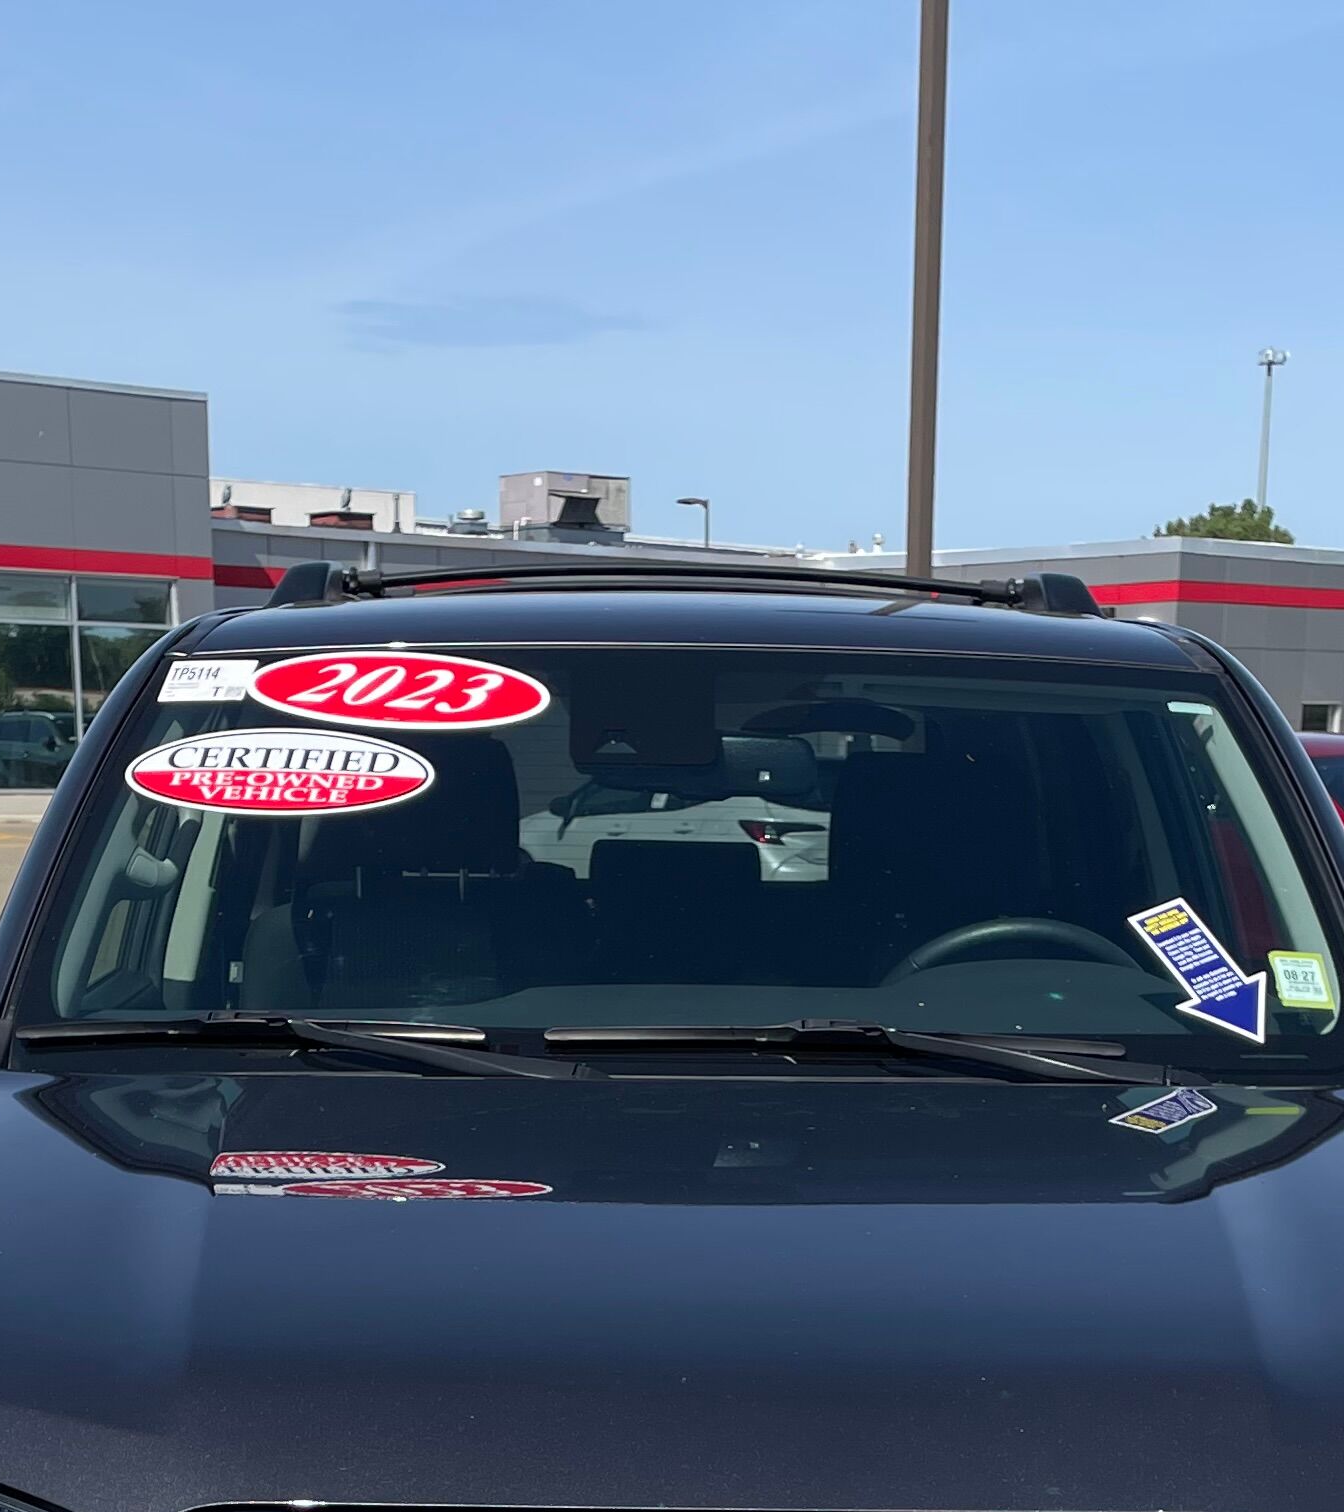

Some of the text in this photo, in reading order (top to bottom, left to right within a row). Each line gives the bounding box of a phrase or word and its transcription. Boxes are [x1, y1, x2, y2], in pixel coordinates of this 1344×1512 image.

[171, 667, 221, 680] TP5114
[287, 662, 504, 714] 2023
[168, 746, 400, 774] CERTIFIED
[171, 771, 383, 791] PRE-OWNED
[199, 785, 348, 804] VEHICLE
